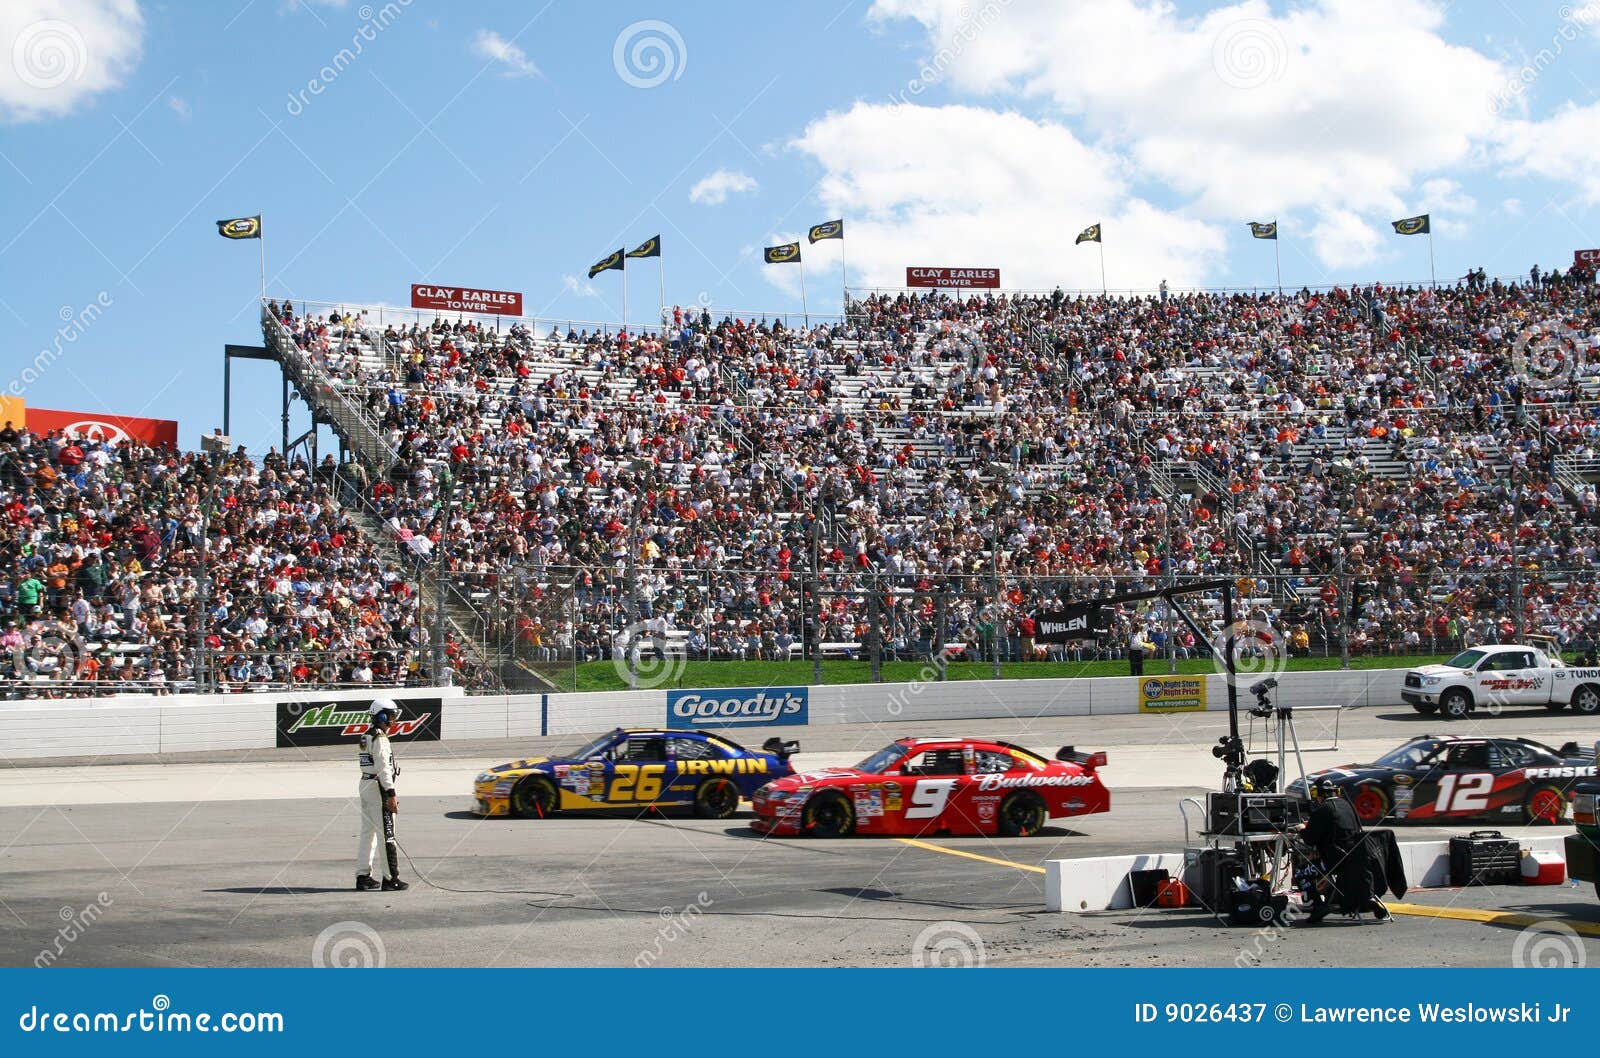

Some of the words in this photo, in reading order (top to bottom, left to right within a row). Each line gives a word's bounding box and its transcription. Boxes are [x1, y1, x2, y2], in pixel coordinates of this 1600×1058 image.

[912, 269, 943, 278] CLAY
[950, 270, 996, 279] EARLES
[416, 287, 455, 299] CLAY
[462, 291, 516, 304] EARLES
[446, 300, 488, 311] TOWER
[1040, 614, 1087, 634] WHELEN
[1163, 688, 1181, 697] Right
[1182, 688, 1200, 696] Price
[673, 692, 803, 723] Goody's
[676, 758, 768, 775] IRWIN
[1524, 766, 1598, 779] PENSKE
[608, 764, 666, 801] 26
[971, 772, 1095, 791] Budweiser
[904, 778, 959, 819] 9
[1434, 773, 1495, 813] 12
